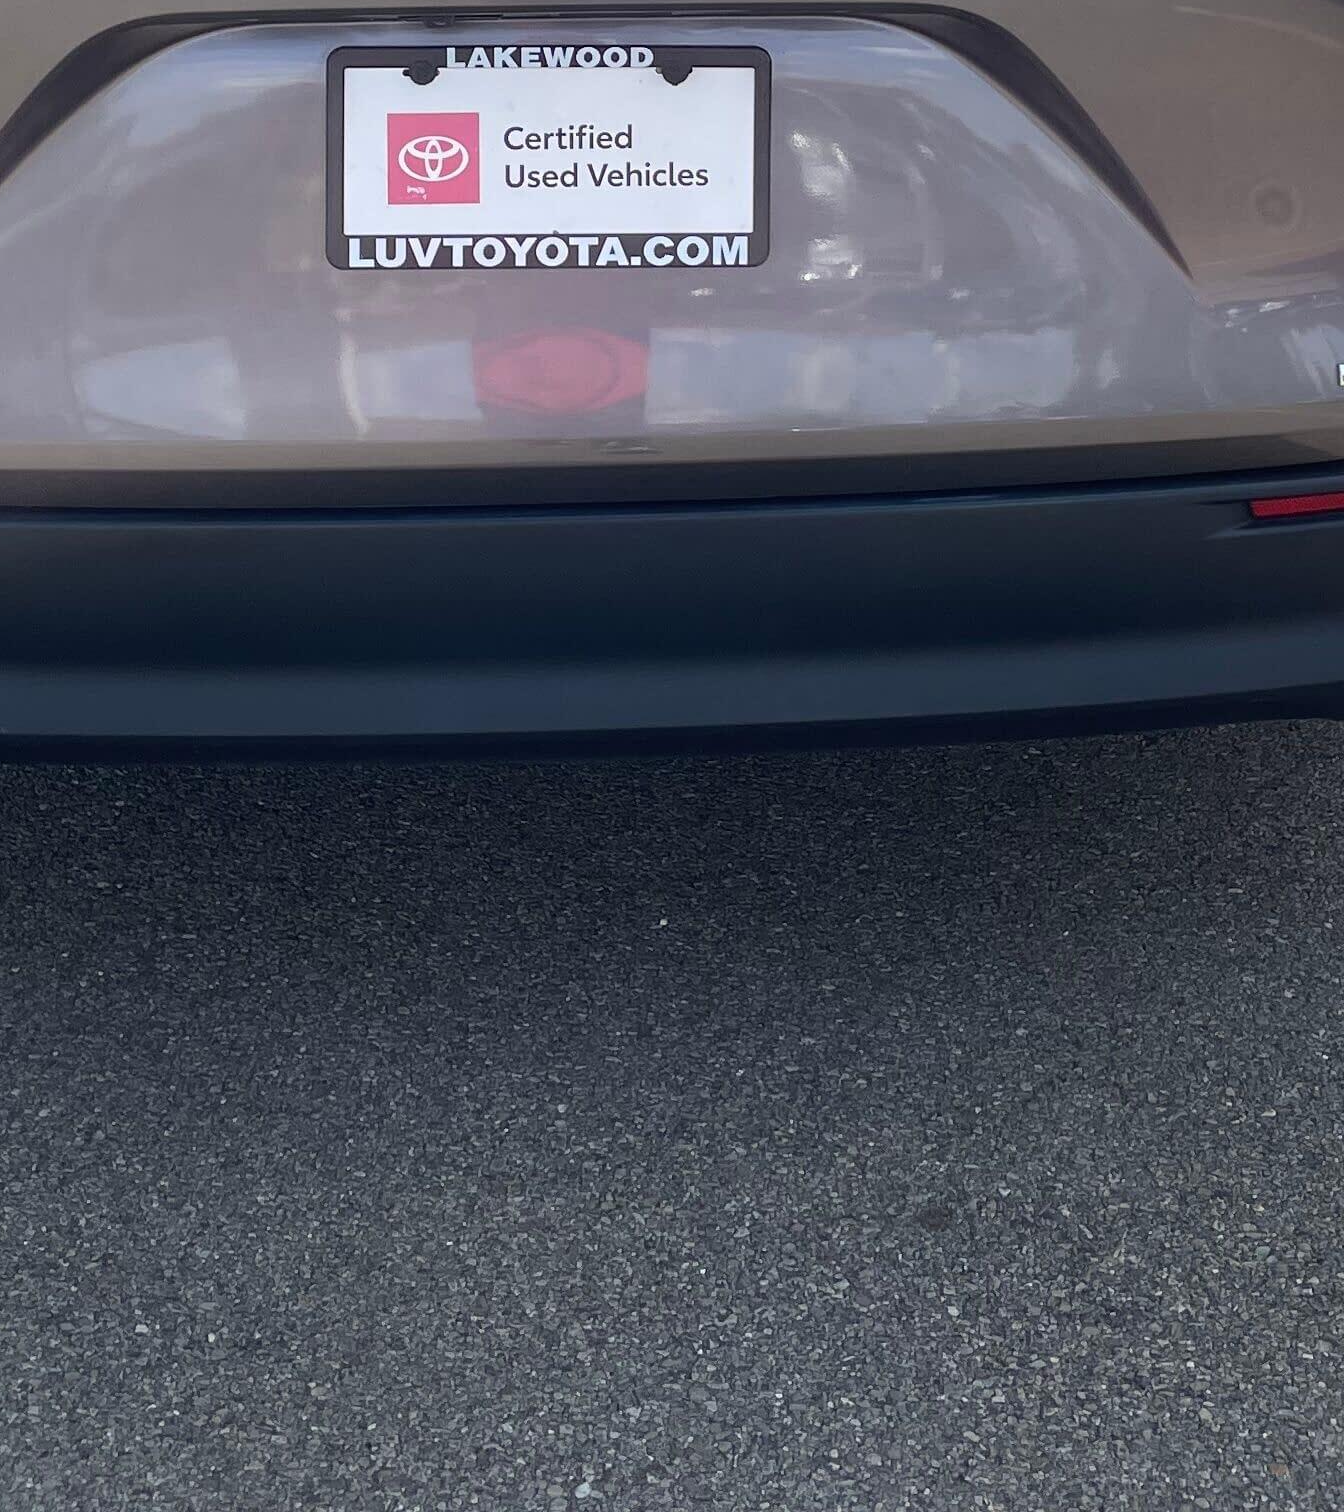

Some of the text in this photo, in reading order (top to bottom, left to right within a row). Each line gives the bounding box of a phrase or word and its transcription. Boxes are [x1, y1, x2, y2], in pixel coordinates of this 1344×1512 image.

[446, 46, 654, 68] LAKEWOOD
[504, 124, 633, 150] Certified
[504, 162, 709, 188] Used Vehicles
[348, 236, 748, 268] LUVTOYOTA.COM
